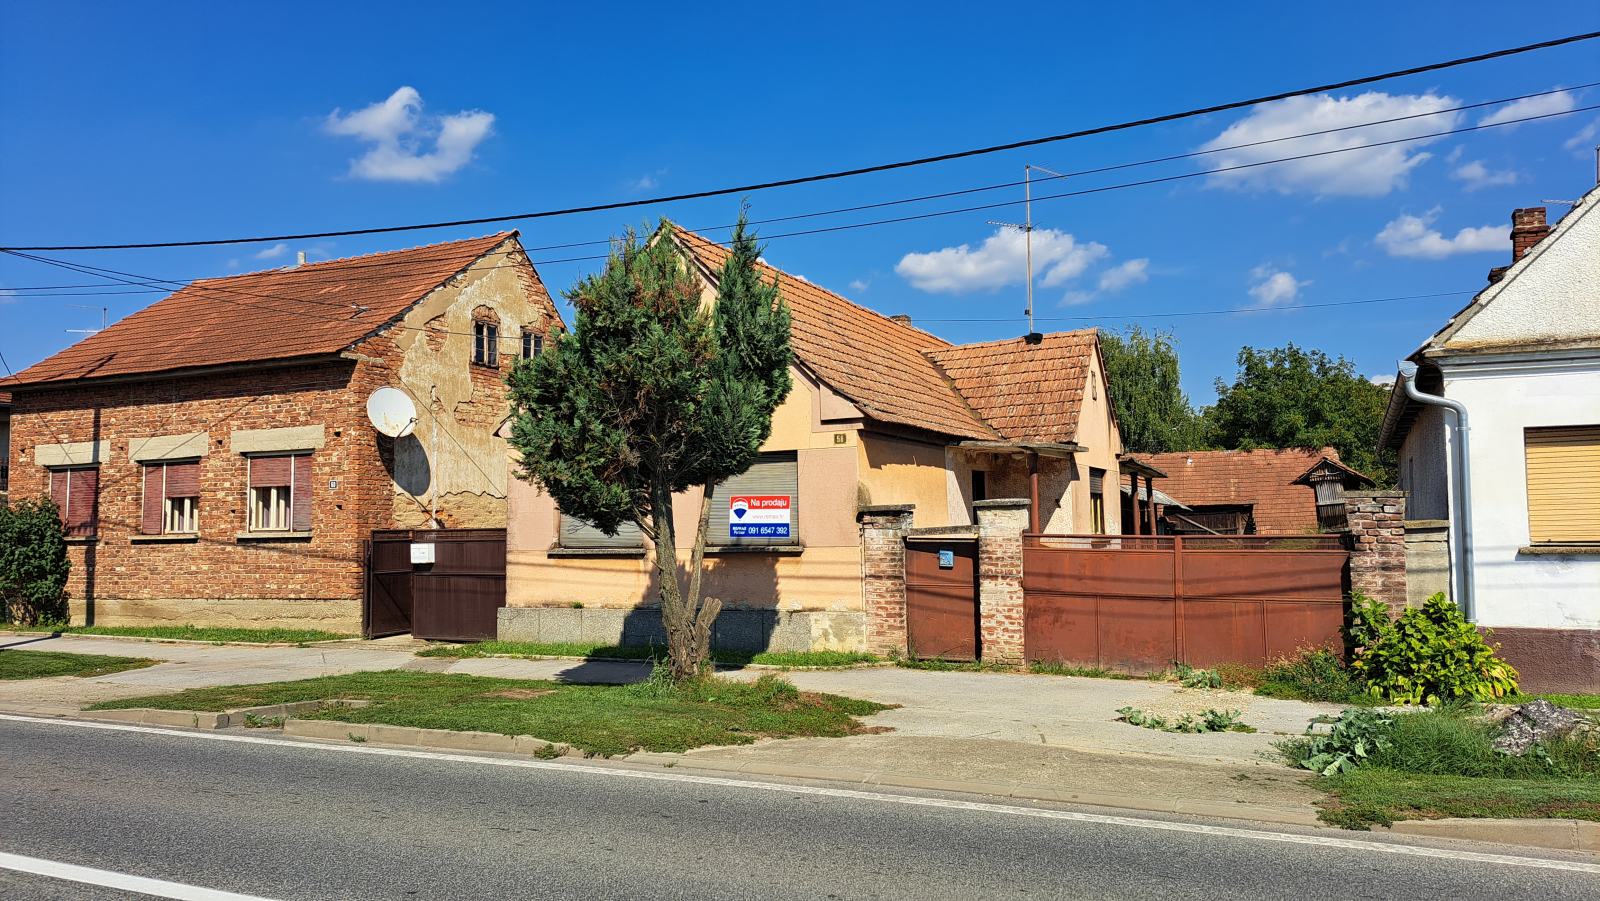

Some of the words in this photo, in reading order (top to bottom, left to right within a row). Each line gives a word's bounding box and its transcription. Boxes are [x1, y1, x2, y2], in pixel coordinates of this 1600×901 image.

[762, 499, 787, 508] prodaju
[748, 526, 759, 534] 091
[760, 526, 775, 534] 6547
[776, 526, 788, 535] 392
